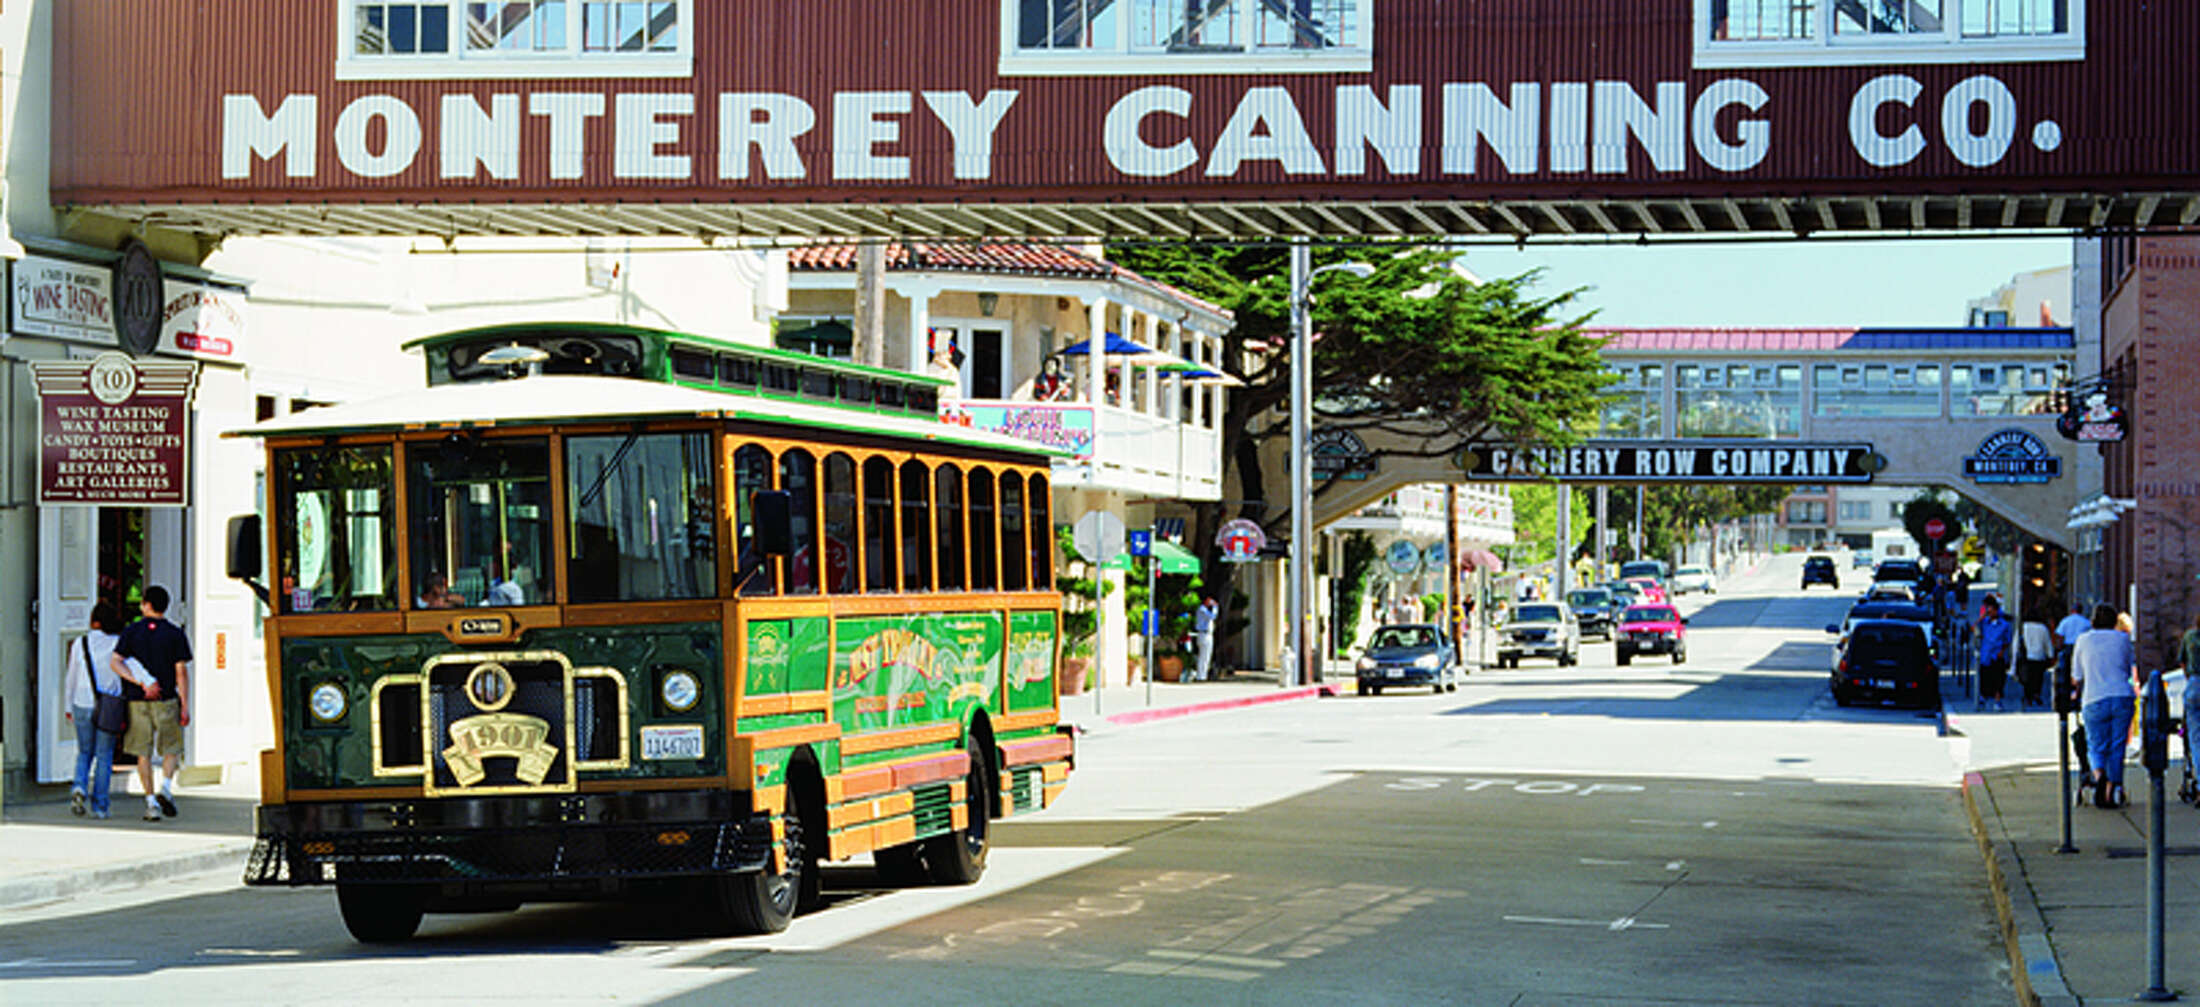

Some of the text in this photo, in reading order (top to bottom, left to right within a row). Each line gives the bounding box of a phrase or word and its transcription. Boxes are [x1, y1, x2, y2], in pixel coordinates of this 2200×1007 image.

[222, 73, 2062, 180] MONTEREY CANNING CO.
[33, 284, 109, 323] WINE TASTING
[57, 406, 169, 419] WINE TASTING
[60, 420, 166, 433] WAX MUSEUM
[44, 434, 181, 448] CANDY TOYS GIFTS
[68, 448, 157, 461] BOUTIQUES
[1492, 447, 1850, 476] CANNERY ROW COMPANY
[57, 462, 167, 474] RESTAURANTS
[54, 475, 170, 489] ART GALLERIES
[462, 723, 539, 753] 1901
[1384, 777, 1646, 796] STOP
